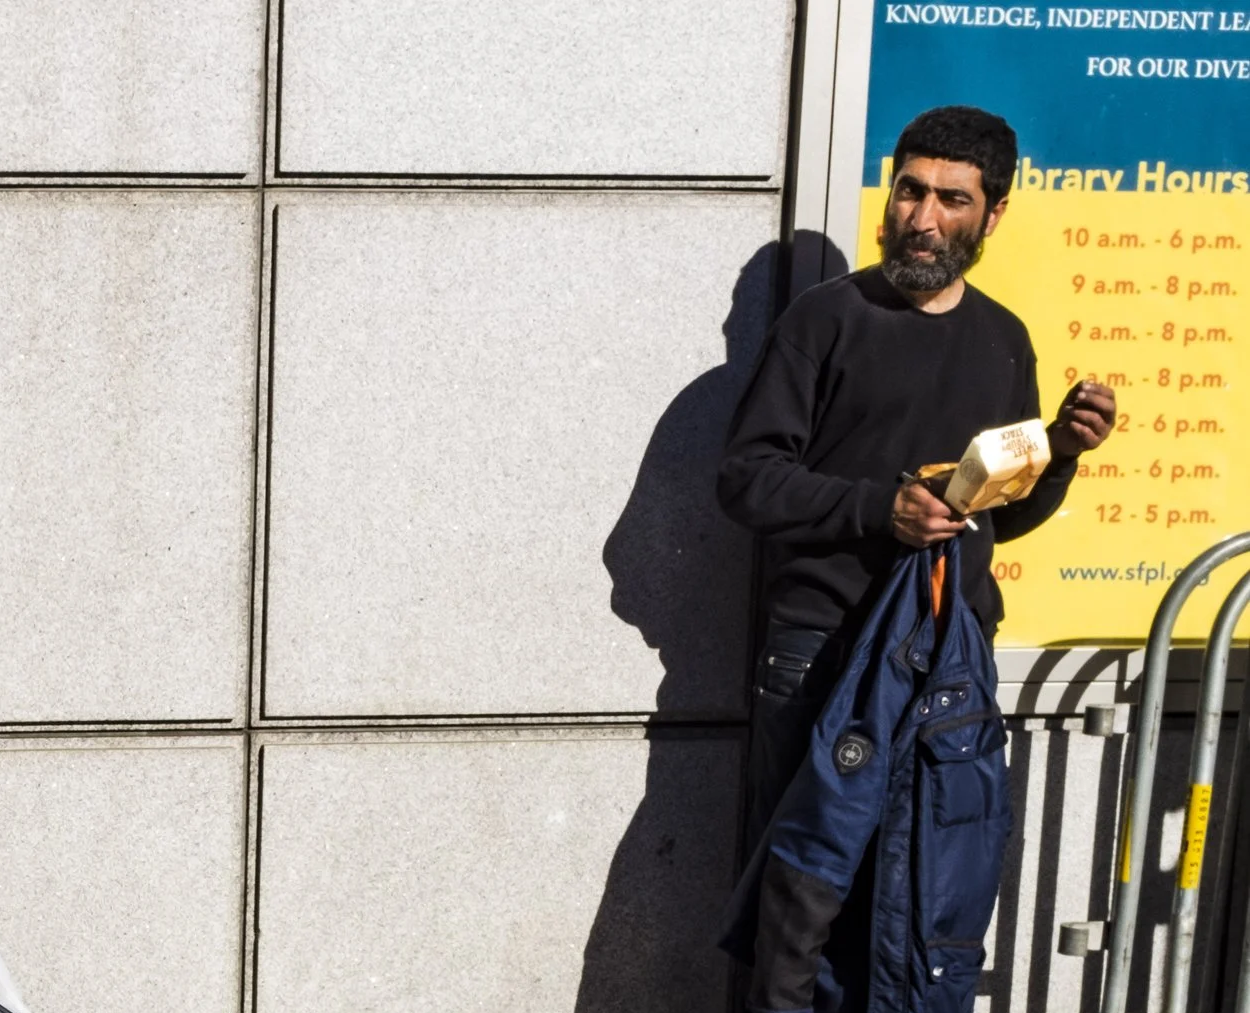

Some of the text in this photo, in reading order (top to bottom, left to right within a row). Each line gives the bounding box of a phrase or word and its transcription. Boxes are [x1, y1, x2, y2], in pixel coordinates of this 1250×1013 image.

[885, 4, 1041, 30] KNOWLEDGE,
[1047, 7, 1214, 31] INDEPENDENT
[1086, 56, 1133, 78] FOR
[1137, 57, 1190, 78] OUR
[1136, 160, 1250, 194] Hours
[1062, 227, 1090, 248] 10
[1097, 232, 1146, 248] a.m.
[1169, 229, 1184, 249] 6
[1191, 234, 1242, 254] p.m.
[1071, 273, 1086, 295] 9
[1093, 279, 1142, 295] a.m.
[1165, 275, 1180, 296] 8
[1187, 280, 1238, 301] p.m.
[1068, 320, 1082, 340] 9
[1089, 325, 1138, 341] a.m.
[1161, 321, 1176, 342] 8
[1183, 327, 1233, 347] p.m.
[1064, 366, 1078, 387] 9
[1156, 368, 1171, 388] 8
[1179, 373, 1229, 393] p.m.
[1000, 426, 1024, 441] STACK
[1152, 413, 1167, 433] 6
[1174, 418, 1226, 439] p.m.
[1077, 462, 1126, 479] a.m.
[1148, 458, 1163, 478] 6
[1170, 463, 1221, 484] p.m.
[1096, 504, 1123, 523] 12
[1145, 504, 1159, 523] 5
[1166, 509, 1216, 529] p.m.
